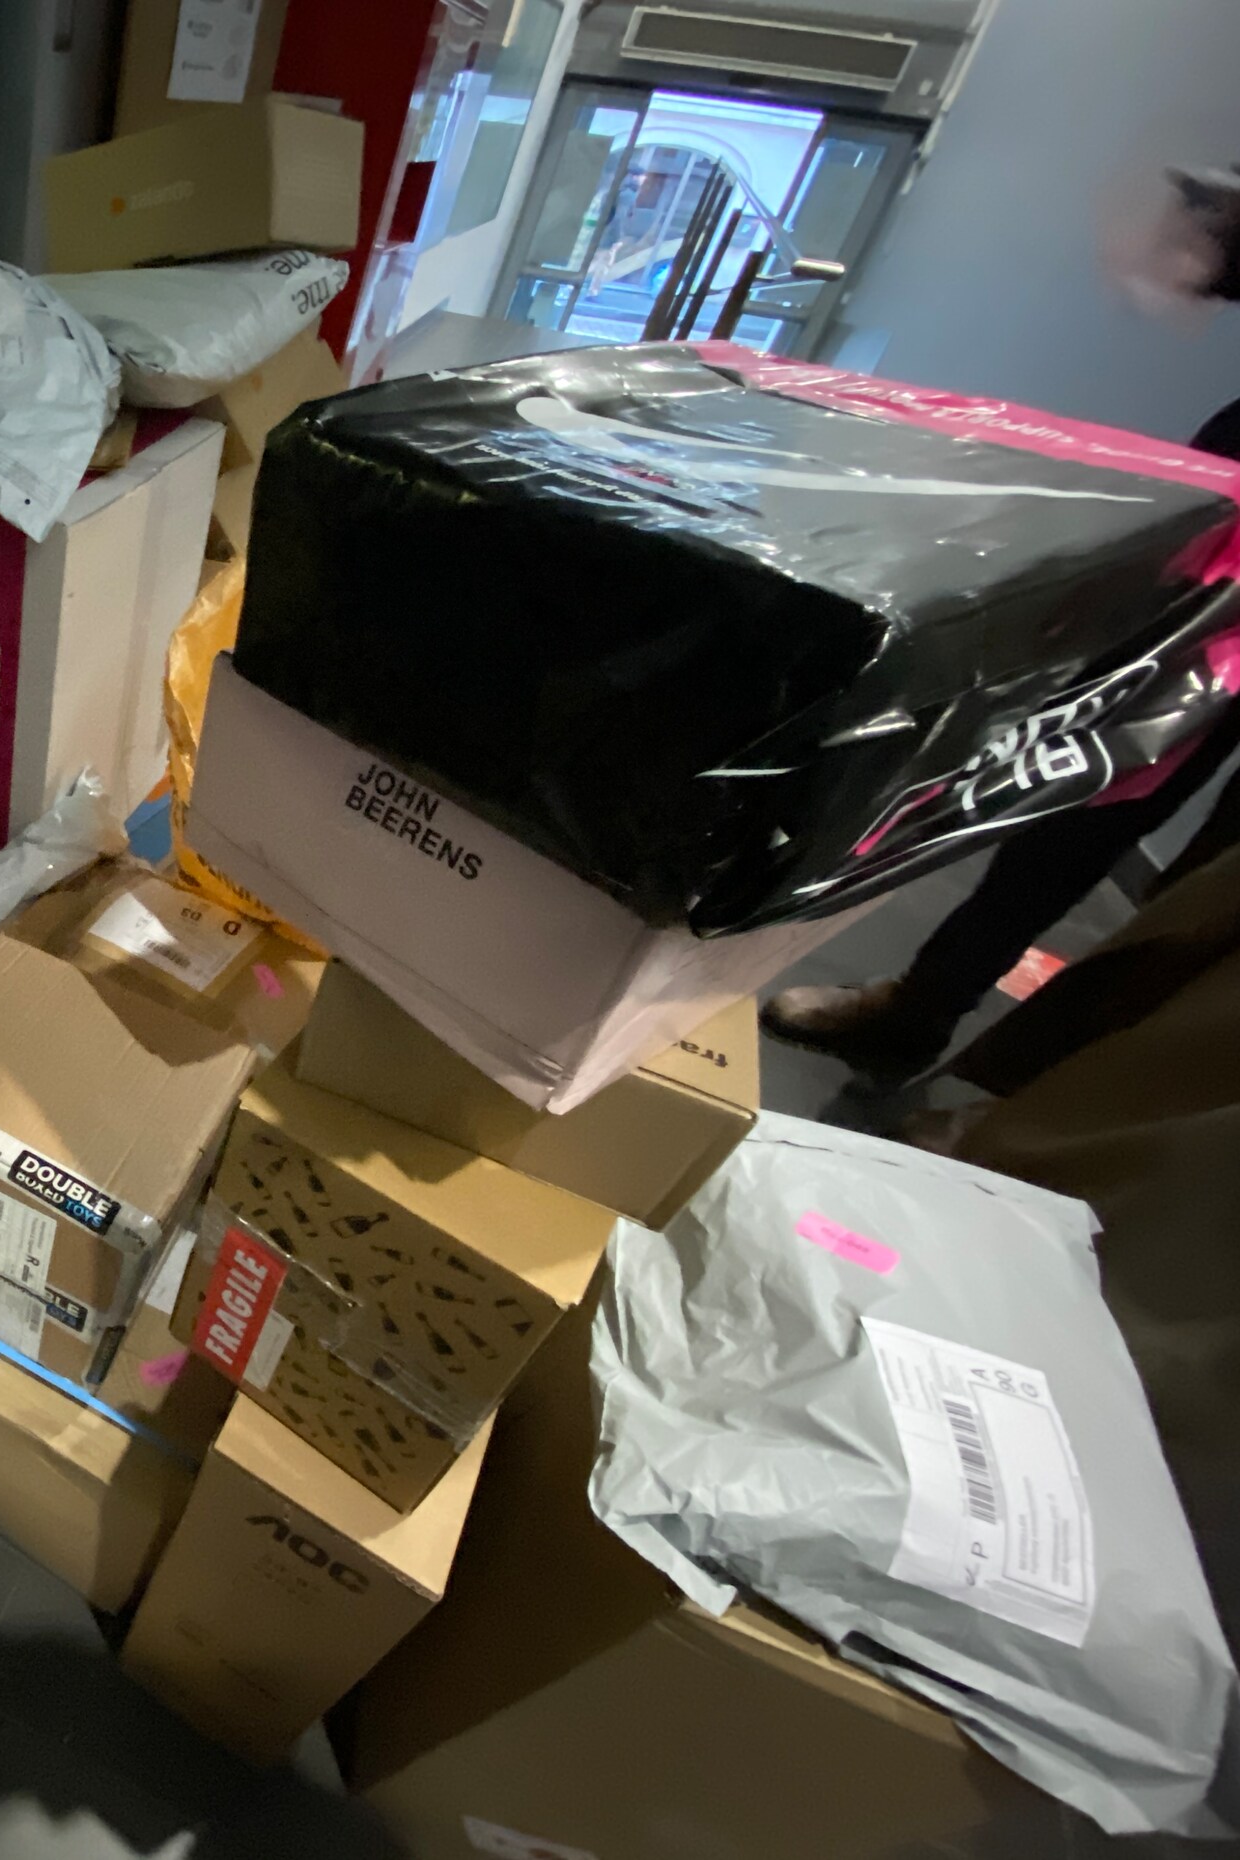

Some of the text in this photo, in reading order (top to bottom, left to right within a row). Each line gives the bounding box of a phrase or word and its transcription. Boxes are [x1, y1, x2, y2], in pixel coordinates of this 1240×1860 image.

[356, 763, 441, 822] JOHN
[344, 784, 485, 882] BEERENS
[19, 1156, 112, 1218] DOUBLE
[64, 1200, 103, 1228] TOYS
[206, 1248, 269, 1366] FRAGILE
[246, 1512, 370, 1596] AOC
